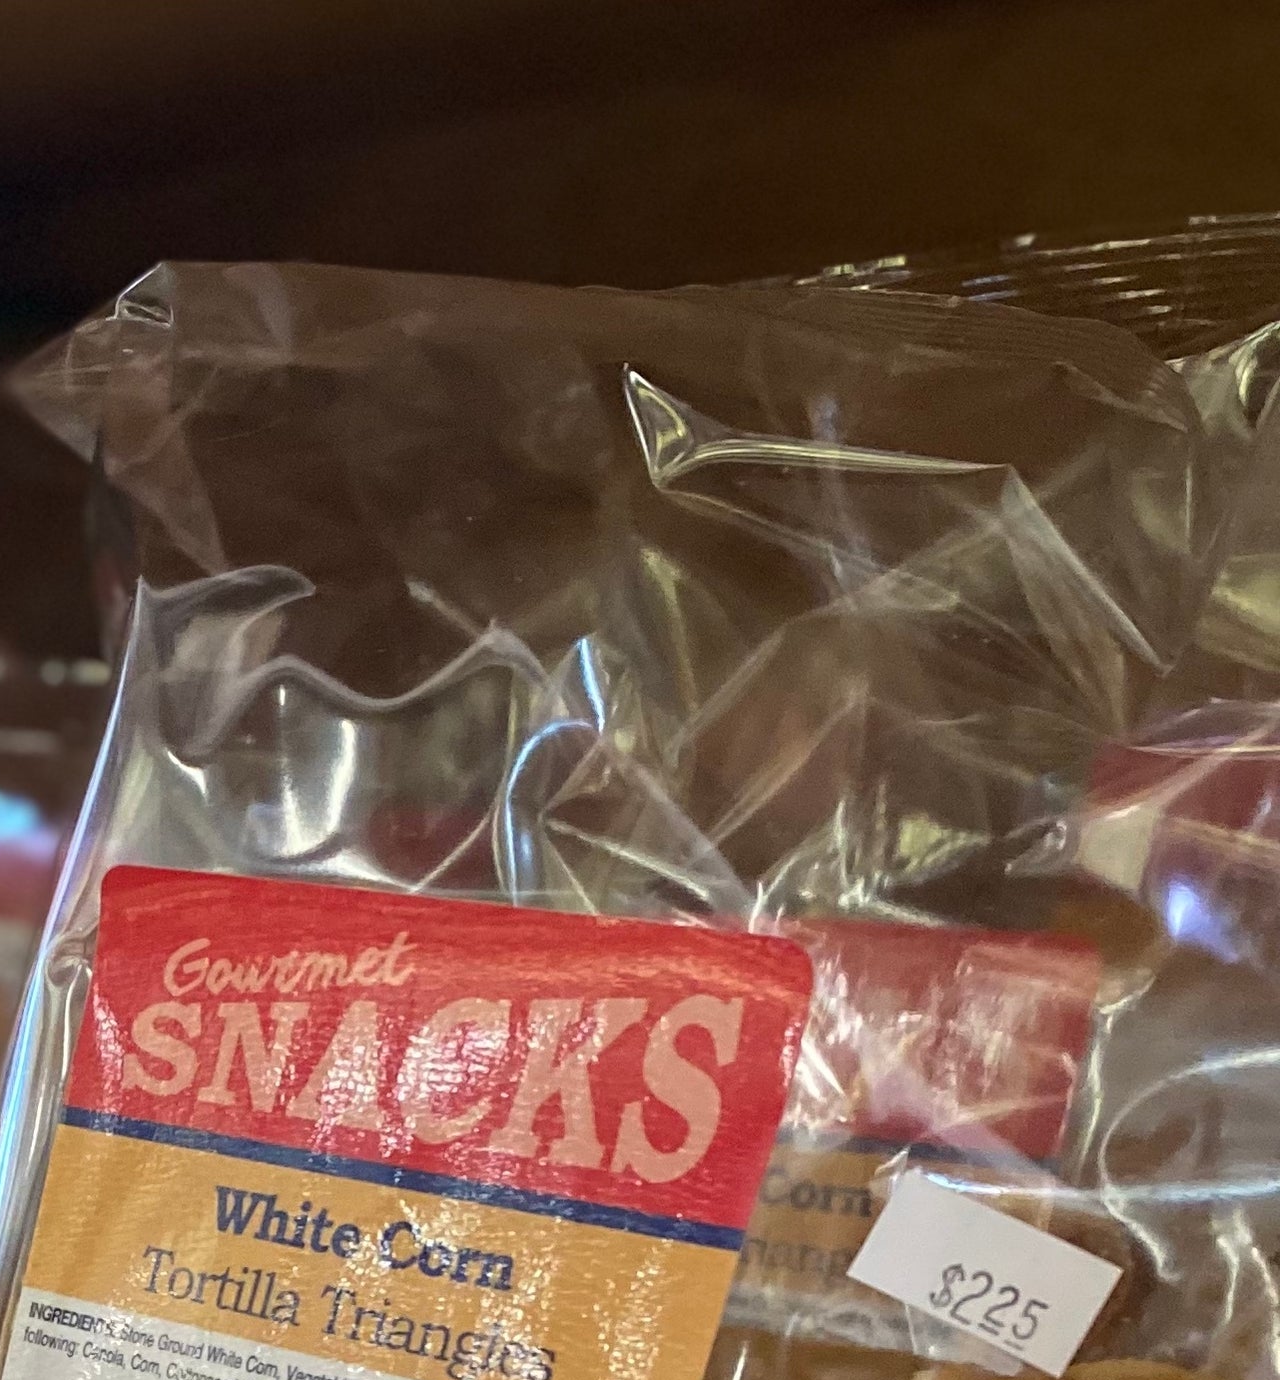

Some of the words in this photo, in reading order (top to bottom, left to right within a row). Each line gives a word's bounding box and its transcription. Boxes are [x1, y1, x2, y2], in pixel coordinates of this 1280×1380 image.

[163, 931, 417, 996] Gourmet
[123, 995, 743, 1184] SNACKS
[214, 1185, 361, 1261] White
[377, 1220, 515, 1291] Corn
[142, 1245, 300, 1327] Tortilla
[23, 1326, 80, 1358] following:
[82, 1341, 126, 1370] Canola,
[130, 1354, 162, 1378] Corn,
[120, 1323, 154, 1347] Stone
[157, 1334, 205, 1360] Ground
[207, 1345, 243, 1369] White
